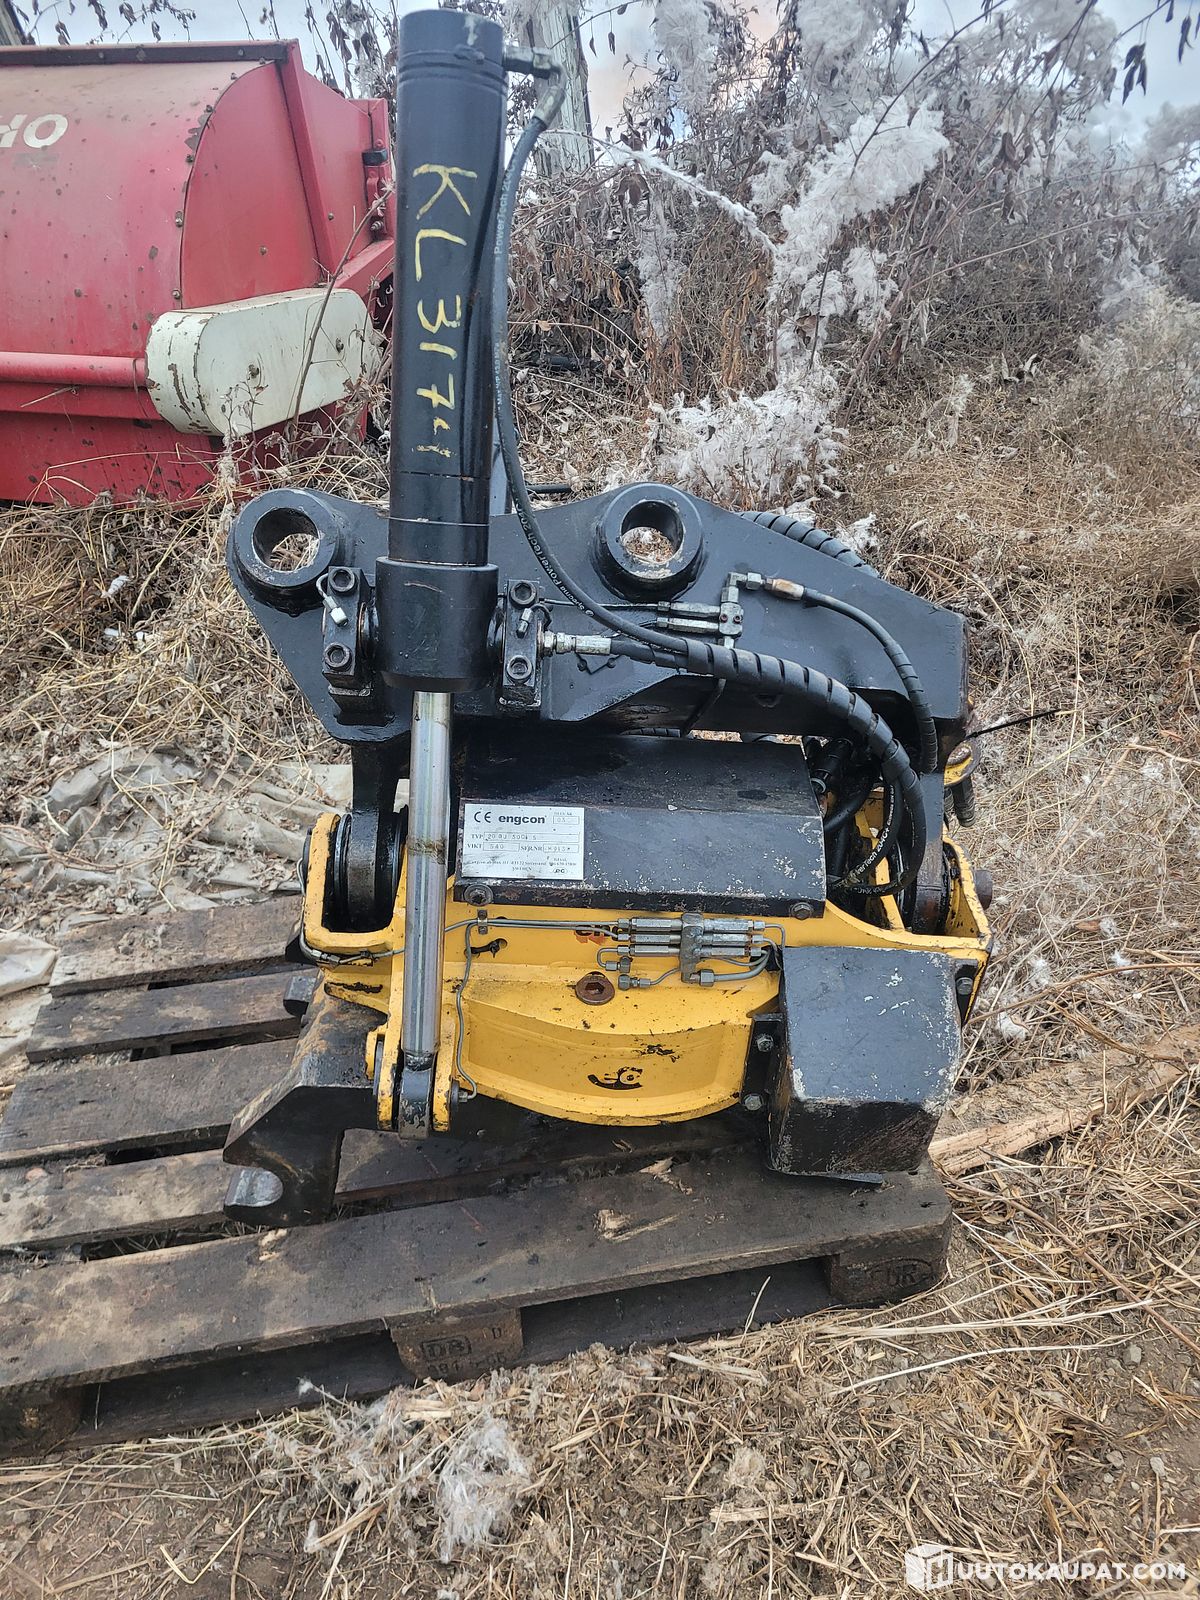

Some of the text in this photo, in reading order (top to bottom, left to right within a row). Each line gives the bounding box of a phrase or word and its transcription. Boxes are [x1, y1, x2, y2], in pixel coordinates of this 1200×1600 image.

[493, 193, 509, 255] PowerTech
[527, 532, 562, 586] PowerTech
[498, 814, 545, 825] engcon
